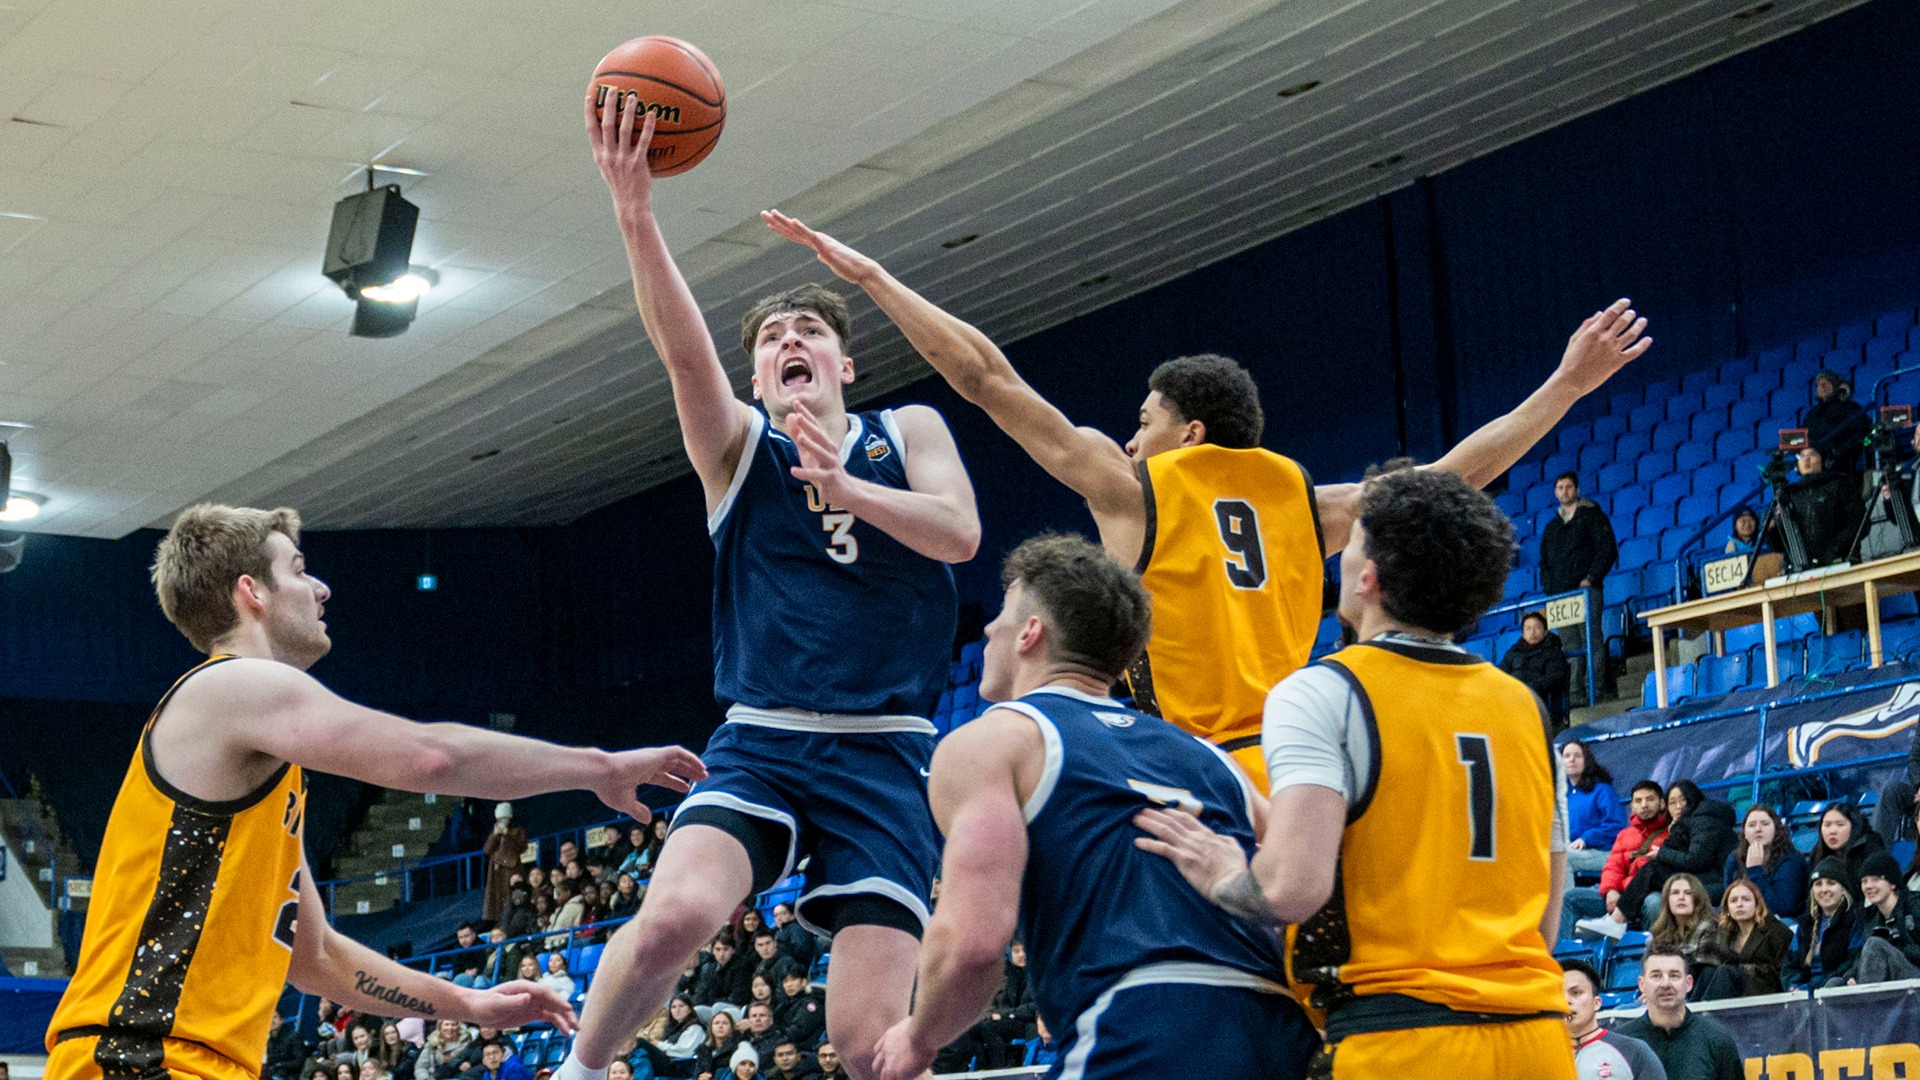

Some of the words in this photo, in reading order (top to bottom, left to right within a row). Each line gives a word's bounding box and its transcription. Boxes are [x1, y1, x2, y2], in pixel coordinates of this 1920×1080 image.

[821, 513, 858, 565] 3
[1212, 498, 1268, 590] 9
[1454, 732, 1497, 862] 1
[355, 970, 437, 1016] Kindness
